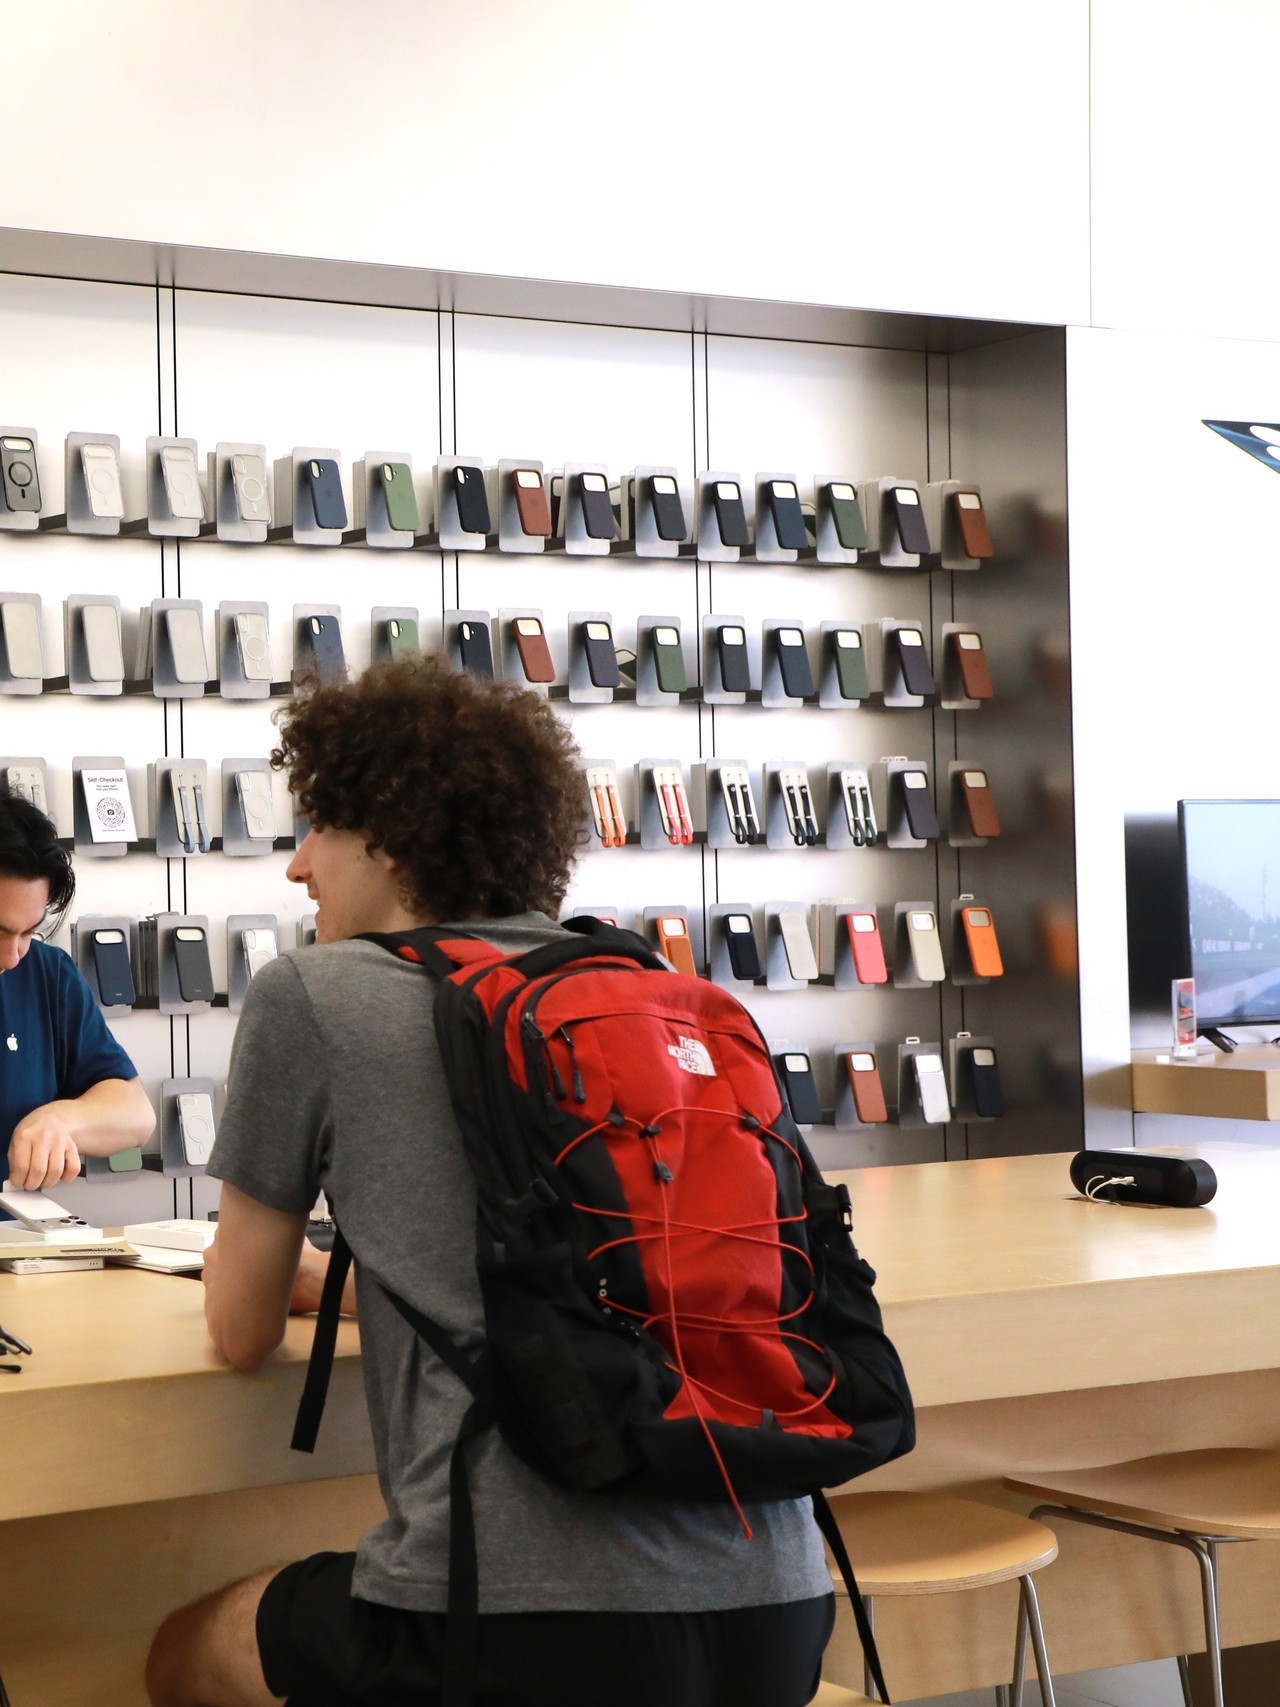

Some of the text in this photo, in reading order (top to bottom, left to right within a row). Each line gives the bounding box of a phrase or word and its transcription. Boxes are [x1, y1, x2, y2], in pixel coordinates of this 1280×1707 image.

[679, 1036, 695, 1050] THE
[668, 1045, 698, 1063] NORTH
[678, 1059, 699, 1074] FACE
